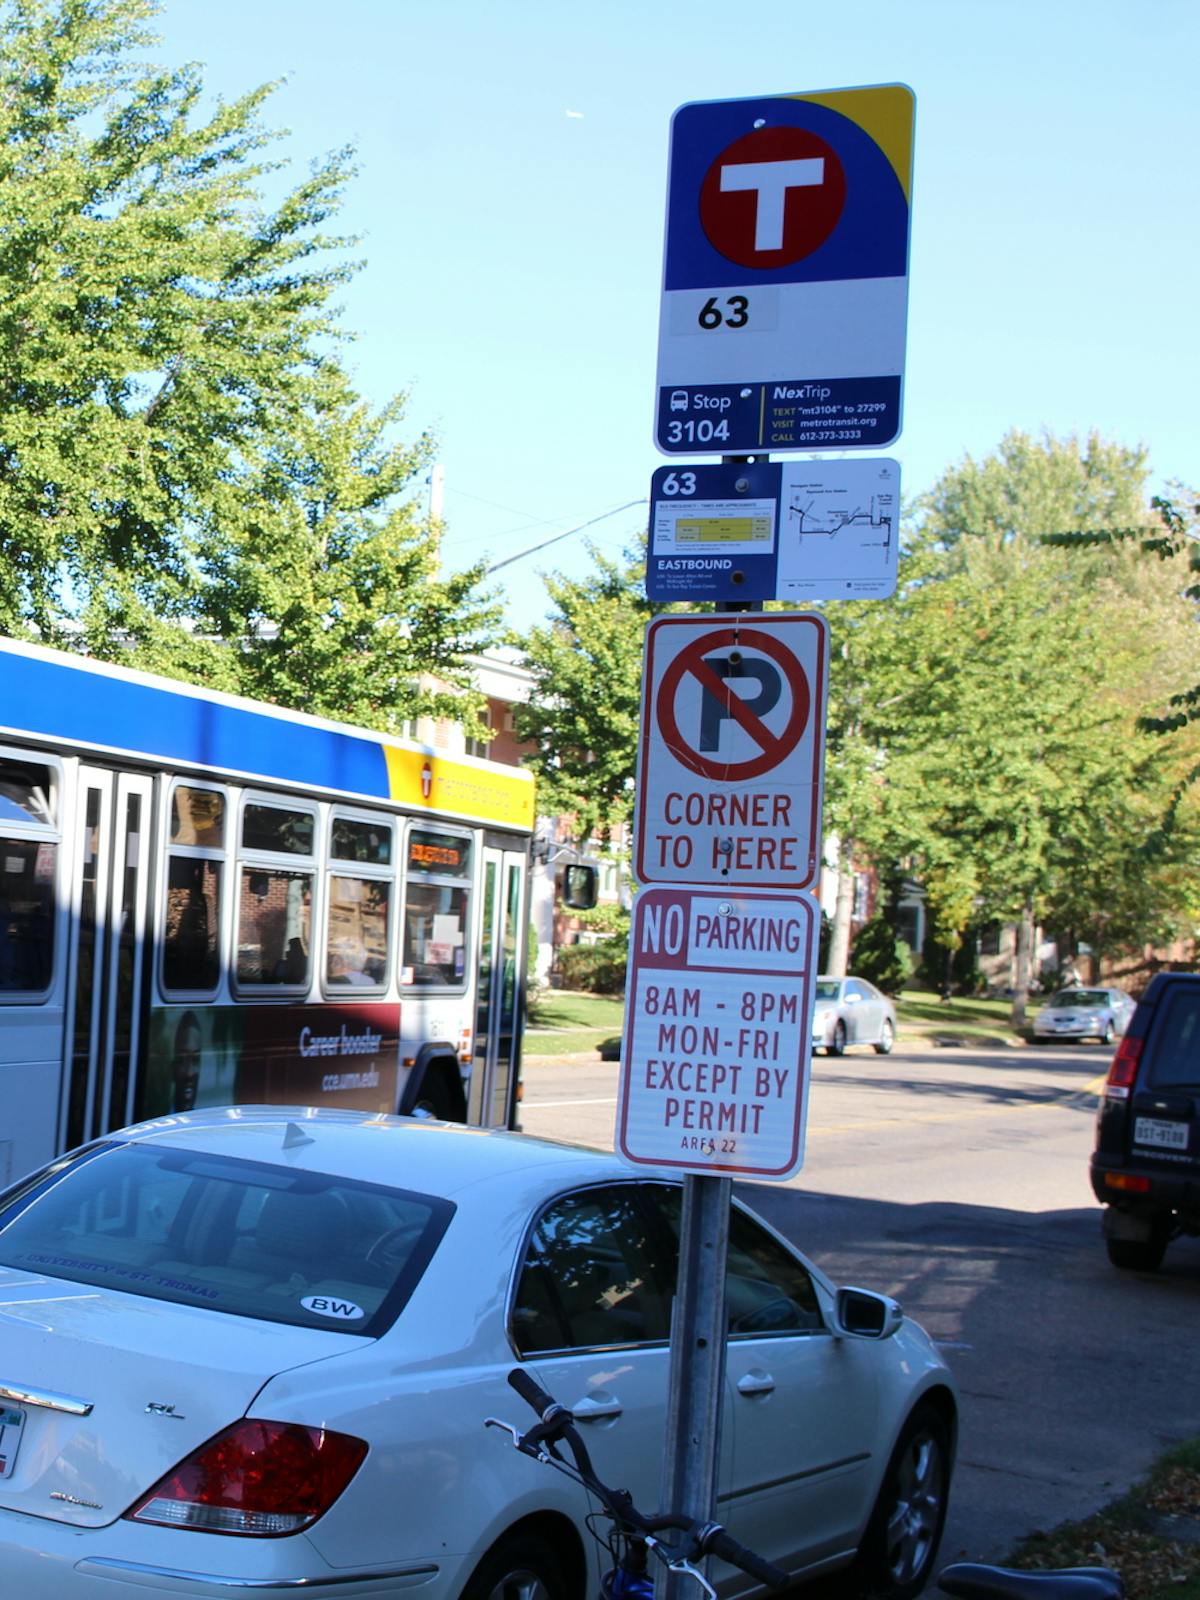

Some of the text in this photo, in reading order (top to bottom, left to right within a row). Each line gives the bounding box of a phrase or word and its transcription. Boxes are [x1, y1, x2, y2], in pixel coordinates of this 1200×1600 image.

[720, 157, 825, 251] T
[698, 295, 749, 330] 63
[693, 394, 731, 413] Stop
[773, 385, 831, 400] NexTrip
[772, 408, 796, 416] TEXT
[844, 405, 854, 413] to
[857, 403, 887, 413] 27299
[772, 417, 877, 428] VISIT metrotransit.org
[667, 419, 730, 443] 3104
[771, 430, 861, 441] CALL 612-373-3333
[662, 472, 697, 496] 63
[658, 559, 732, 571] EASTBOUND
[664, 792, 791, 827] CORNER
[656, 835, 798, 871] TO HERE
[641, 903, 800, 956] NO PARKING
[645, 986, 700, 1018] 8AM
[741, 992, 798, 1024] 8PM
[300, 1024, 382, 1057] Career booster
[658, 1023, 779, 1061] MON-FRI
[645, 1059, 789, 1099] EXCEPT BY
[665, 1098, 765, 1135] PERMIT
[721, 1139, 736, 1153] 22
[27, 1254, 114, 1273] UNIVERSITY
[157, 1278, 220, 1299] THOMAS
[310, 1298, 357, 1317] BW
[144, 1402, 186, 1419] RL
